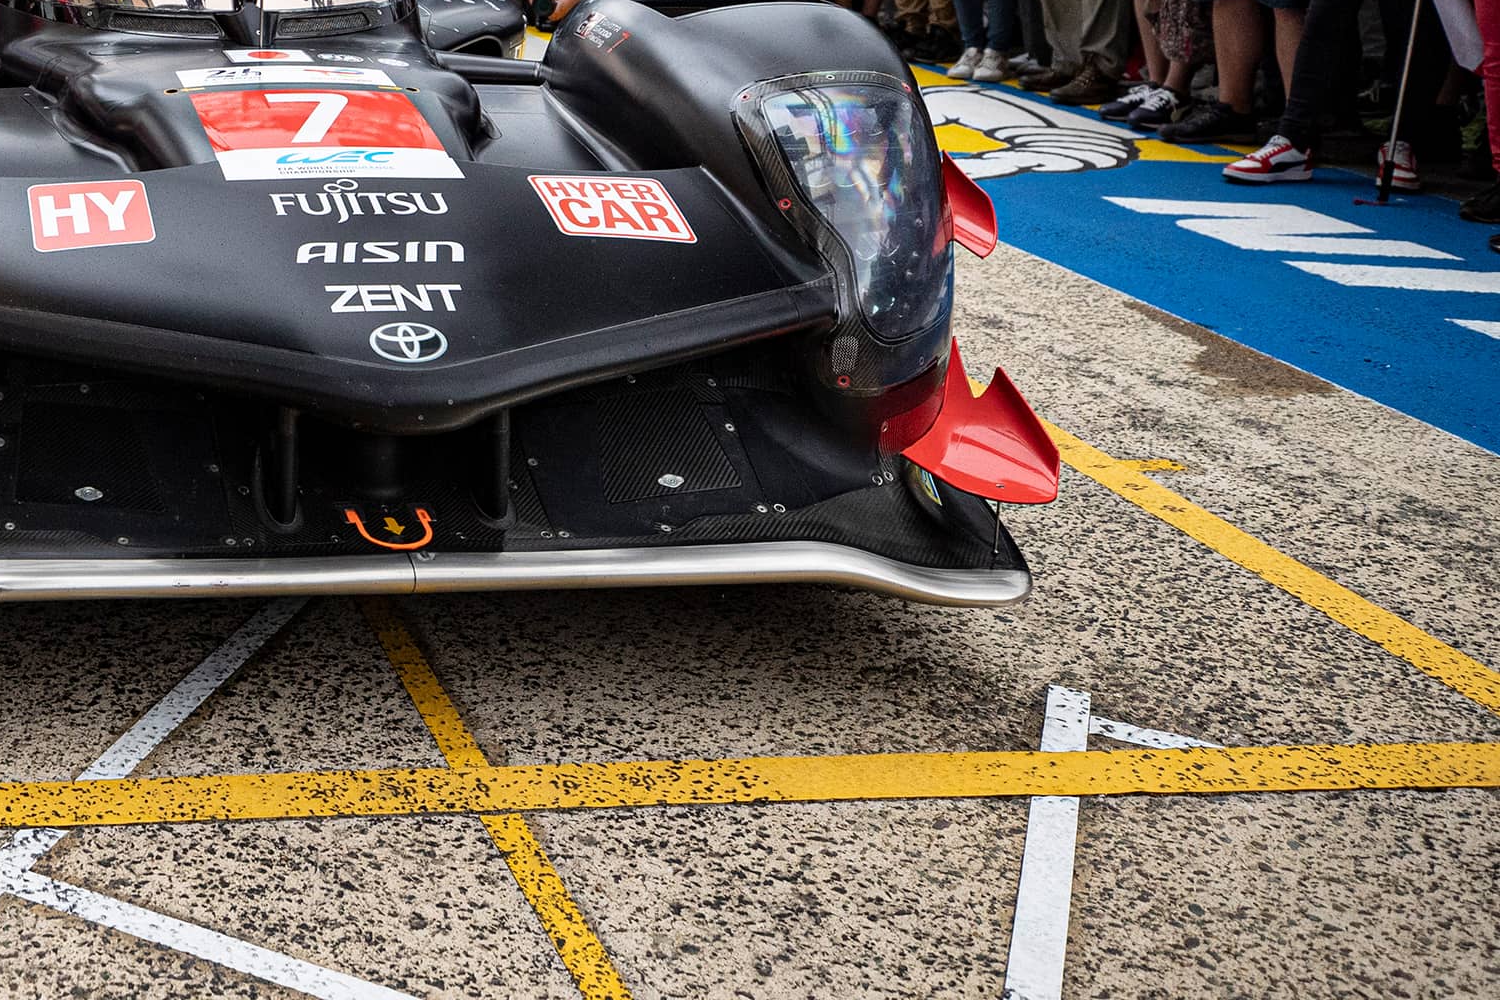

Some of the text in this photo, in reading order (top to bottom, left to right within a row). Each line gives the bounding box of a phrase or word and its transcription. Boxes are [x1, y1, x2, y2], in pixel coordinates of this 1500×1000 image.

[263, 93, 348, 144] 7
[276, 150, 395, 165] WEC
[268, 179, 449, 224] FUJITSU
[543, 181, 660, 201] HYPER
[40, 189, 137, 238] HY
[558, 198, 682, 234] CAR
[296, 240, 466, 264] AISIN
[324, 284, 463, 313] ZENT
